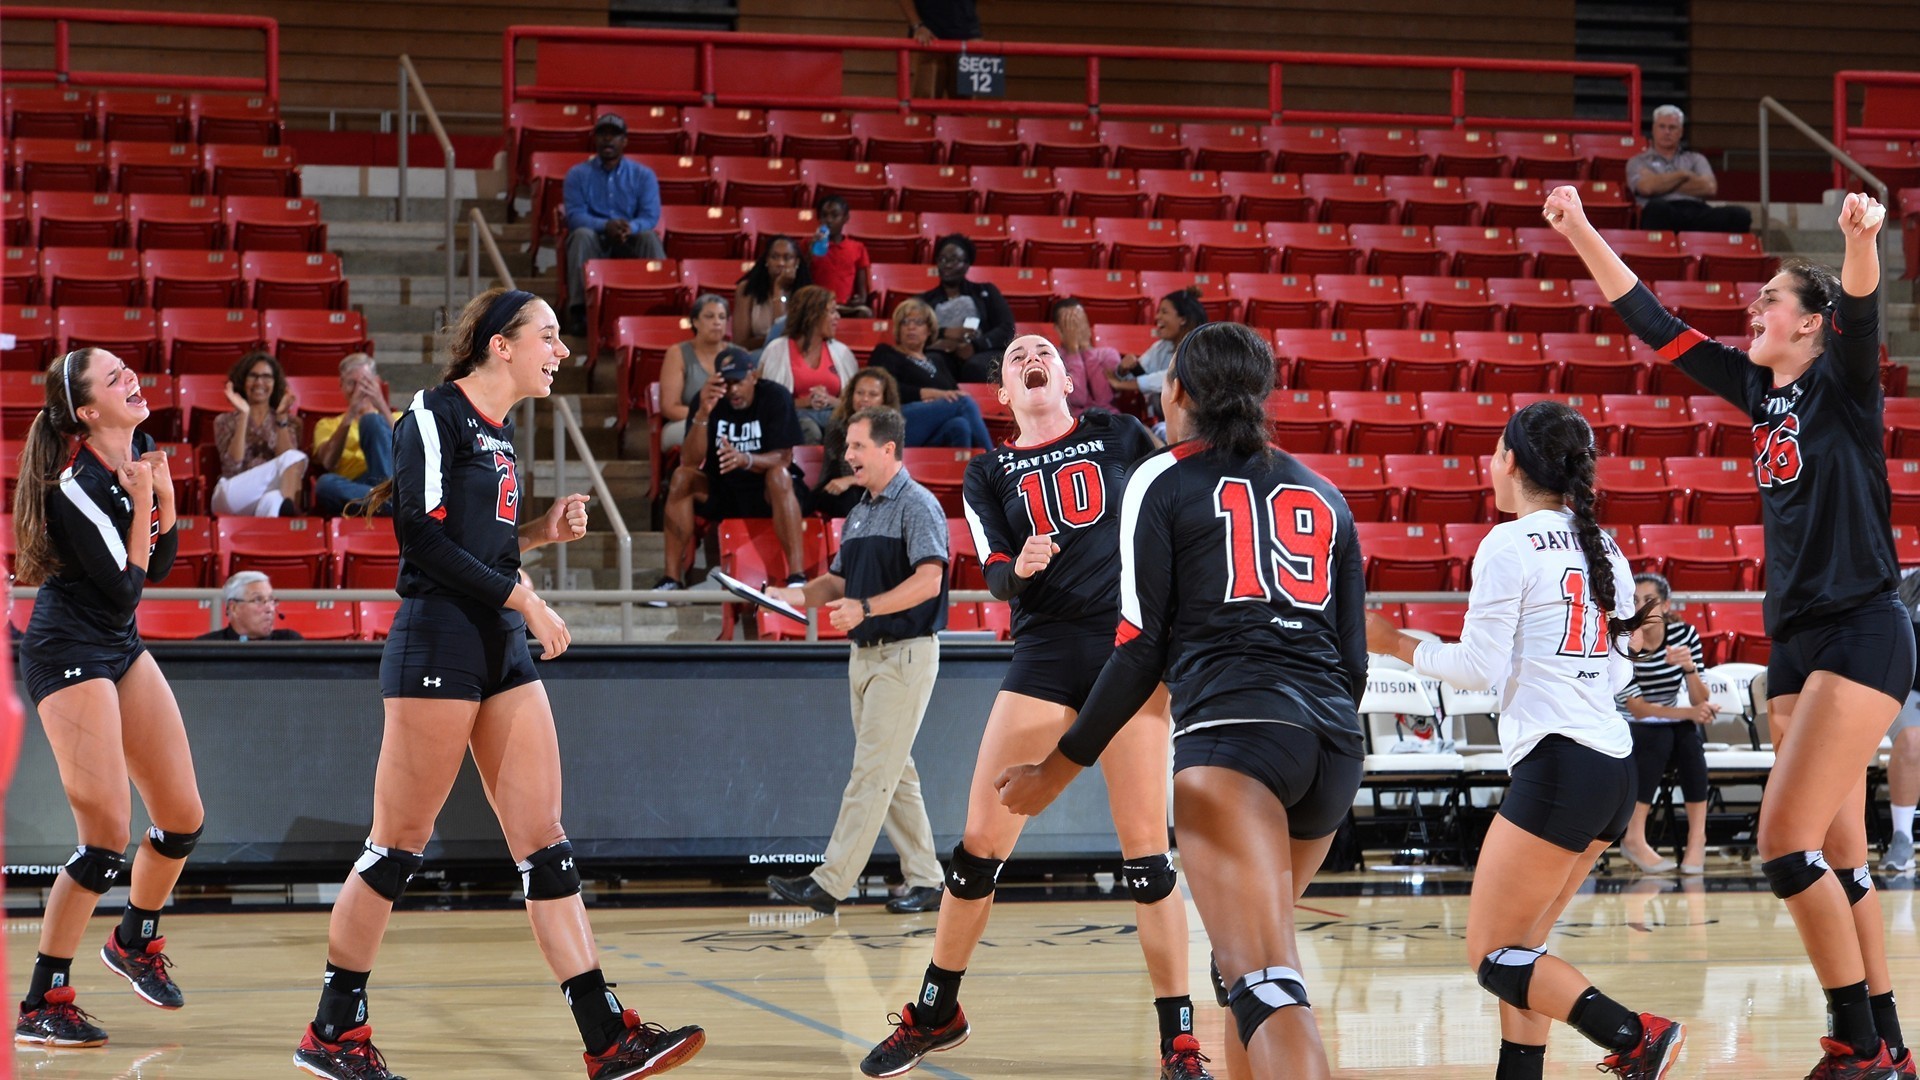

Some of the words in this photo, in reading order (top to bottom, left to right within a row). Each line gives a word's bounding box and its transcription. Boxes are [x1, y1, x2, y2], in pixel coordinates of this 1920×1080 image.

[959, 57, 1003, 73] SECT.
[970, 73, 992, 93] 12
[716, 419, 761, 442] ELON
[494, 451, 519, 525] 2
[1016, 459, 1105, 536] 10
[1213, 476, 1337, 611] 19
[1527, 531, 1620, 558] DAVION
[1366, 681, 1416, 693] VIDSON
[750, 854, 827, 863] DAKTRONIC
[1, 865, 65, 874] KTRONIC
